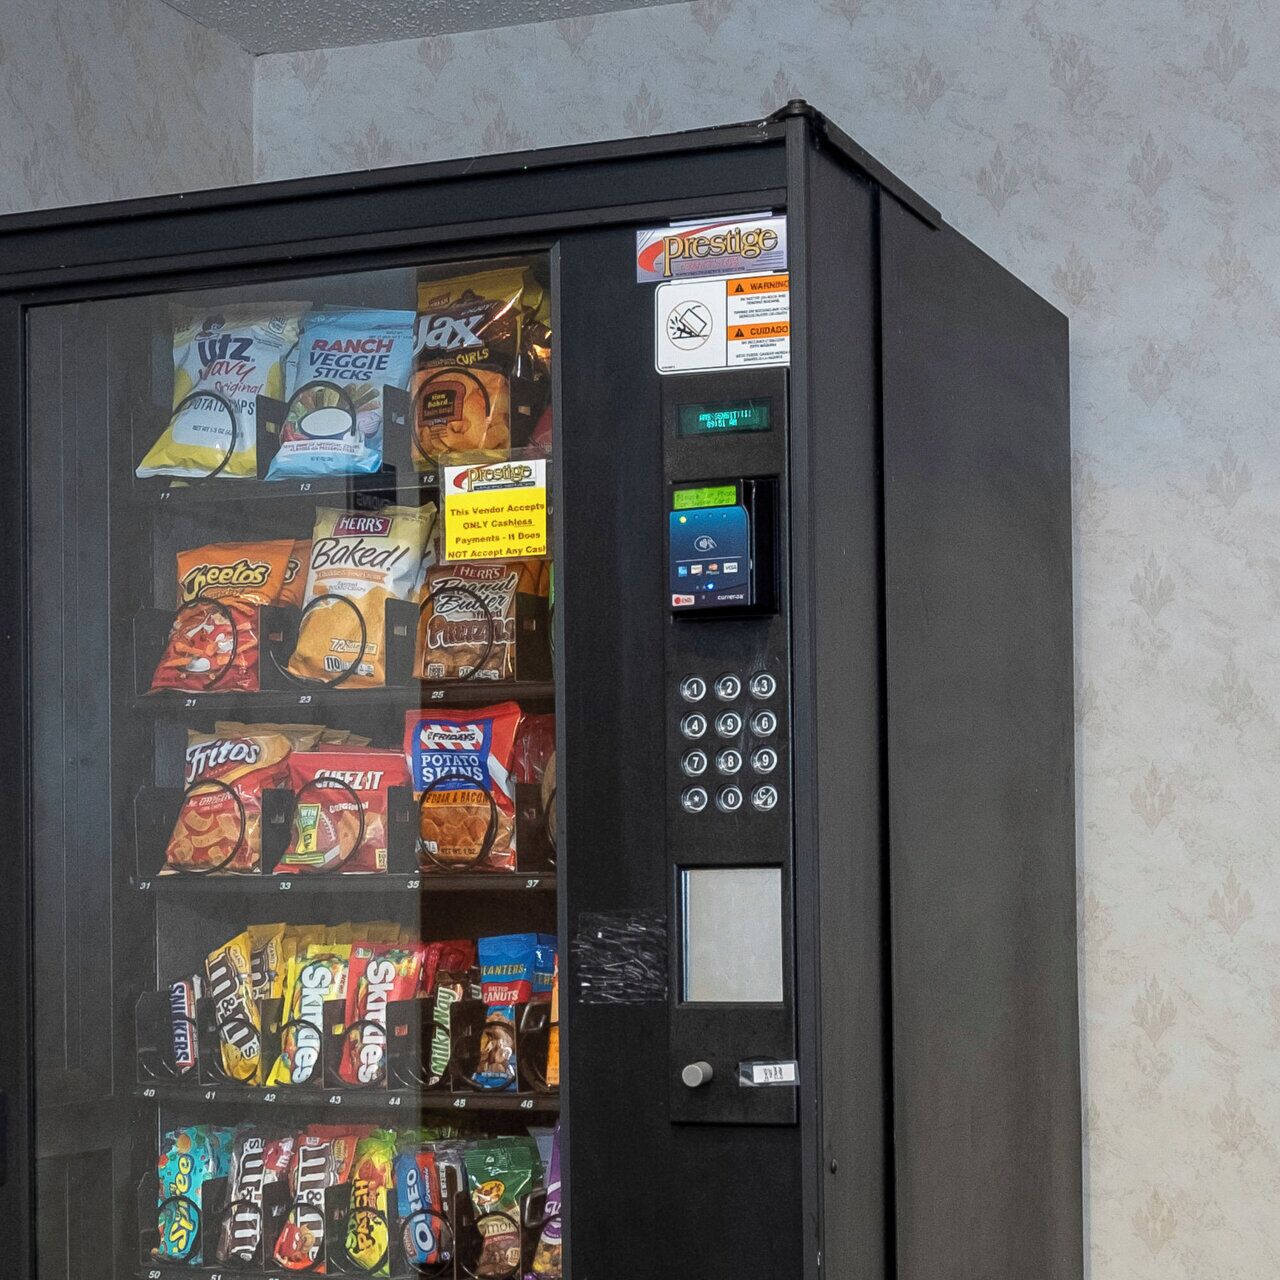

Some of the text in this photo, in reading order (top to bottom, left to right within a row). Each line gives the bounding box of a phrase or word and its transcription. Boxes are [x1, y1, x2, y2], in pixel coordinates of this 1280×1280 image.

[412, 313, 484, 357] Jax
[750, 325, 789, 335] CUIDADO
[312, 339, 394, 353] RANCH
[309, 352, 391, 370] VEGGIE
[457, 348, 489, 366] CURLS
[313, 367, 372, 381] STICKS
[423, 475, 435, 484] 15
[300, 483, 311, 491] 13
[450, 502, 545, 516] This Vendor Accepts
[340, 517, 384, 532] HERR'S
[463, 518, 533, 529] ONLY Cashless
[456, 536, 500, 545] Payments
[312, 537, 410, 571] Baked!
[448, 551, 467, 559] NOT
[470, 549, 502, 558] Accept
[506, 547, 523, 555] Any
[460, 566, 501, 579] HERR'S
[183, 562, 267, 602] Cheetos
[691, 680, 768, 695] 1 2 3
[299, 695, 312, 704] 23
[431, 690, 445, 699] 25
[185, 698, 197, 707] 21
[692, 717, 769, 732] 4 5 6
[186, 740, 260, 783] Fritos
[421, 754, 479, 767] POTATO
[693, 754, 769, 769] 7 8 9
[422, 766, 484, 783] SKINS
[728, 793, 734, 805] 0
[280, 881, 292, 890] 33
[407, 880, 420, 889] 35
[526, 879, 539, 888] 37
[483, 989, 519, 1003] EANUTS
[170, 982, 190, 1065] SNIKERS
[144, 1089, 156, 1098] 40
[205, 1091, 216, 1100] 41
[264, 1093, 276, 1102] 42
[330, 1095, 342, 1104] 43
[389, 1098, 401, 1106] 44
[454, 1099, 466, 1108] 45
[521, 1100, 533, 1109] 46
[406, 1168, 435, 1252] OREO
[148, 1270, 161, 1279] 50
